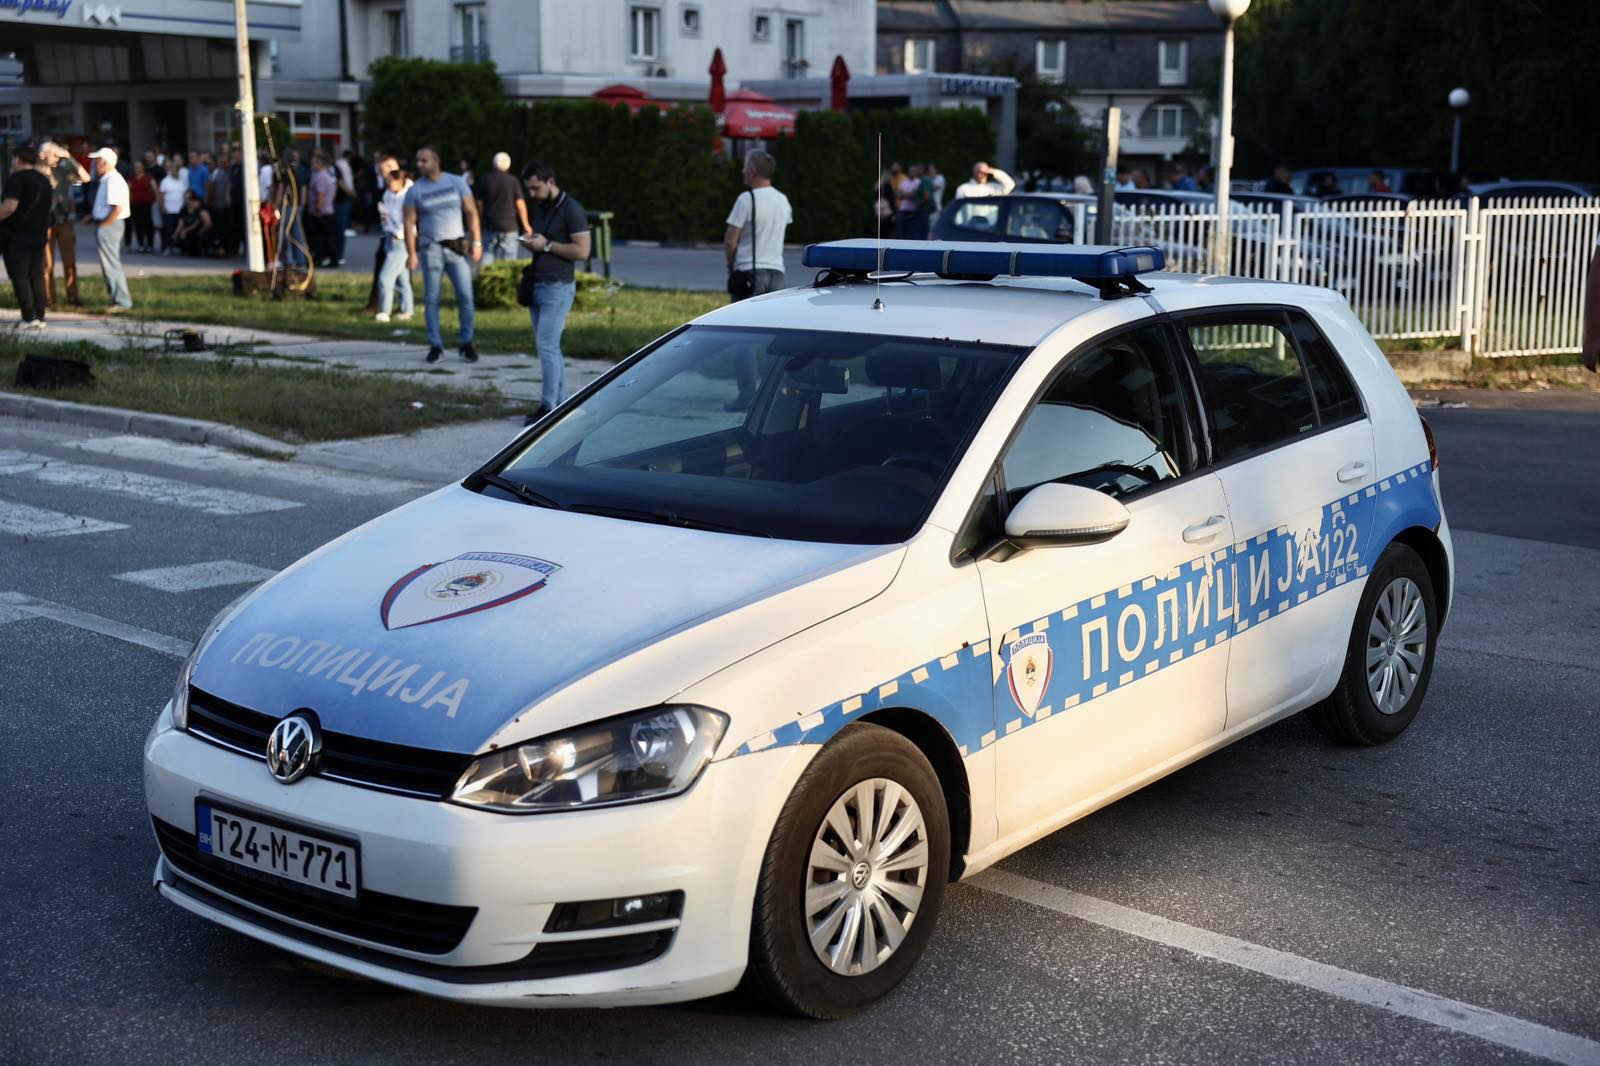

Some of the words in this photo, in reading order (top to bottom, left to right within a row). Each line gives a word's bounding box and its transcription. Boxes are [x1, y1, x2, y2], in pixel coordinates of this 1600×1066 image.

[1321, 523, 1359, 572] 122
[1324, 561, 1360, 580] POLICE
[1081, 530, 1321, 680] ПОЛИЦИЈА
[231, 632, 470, 718] ПОЛИЦИЈА
[213, 814, 352, 891] T24-M-771
